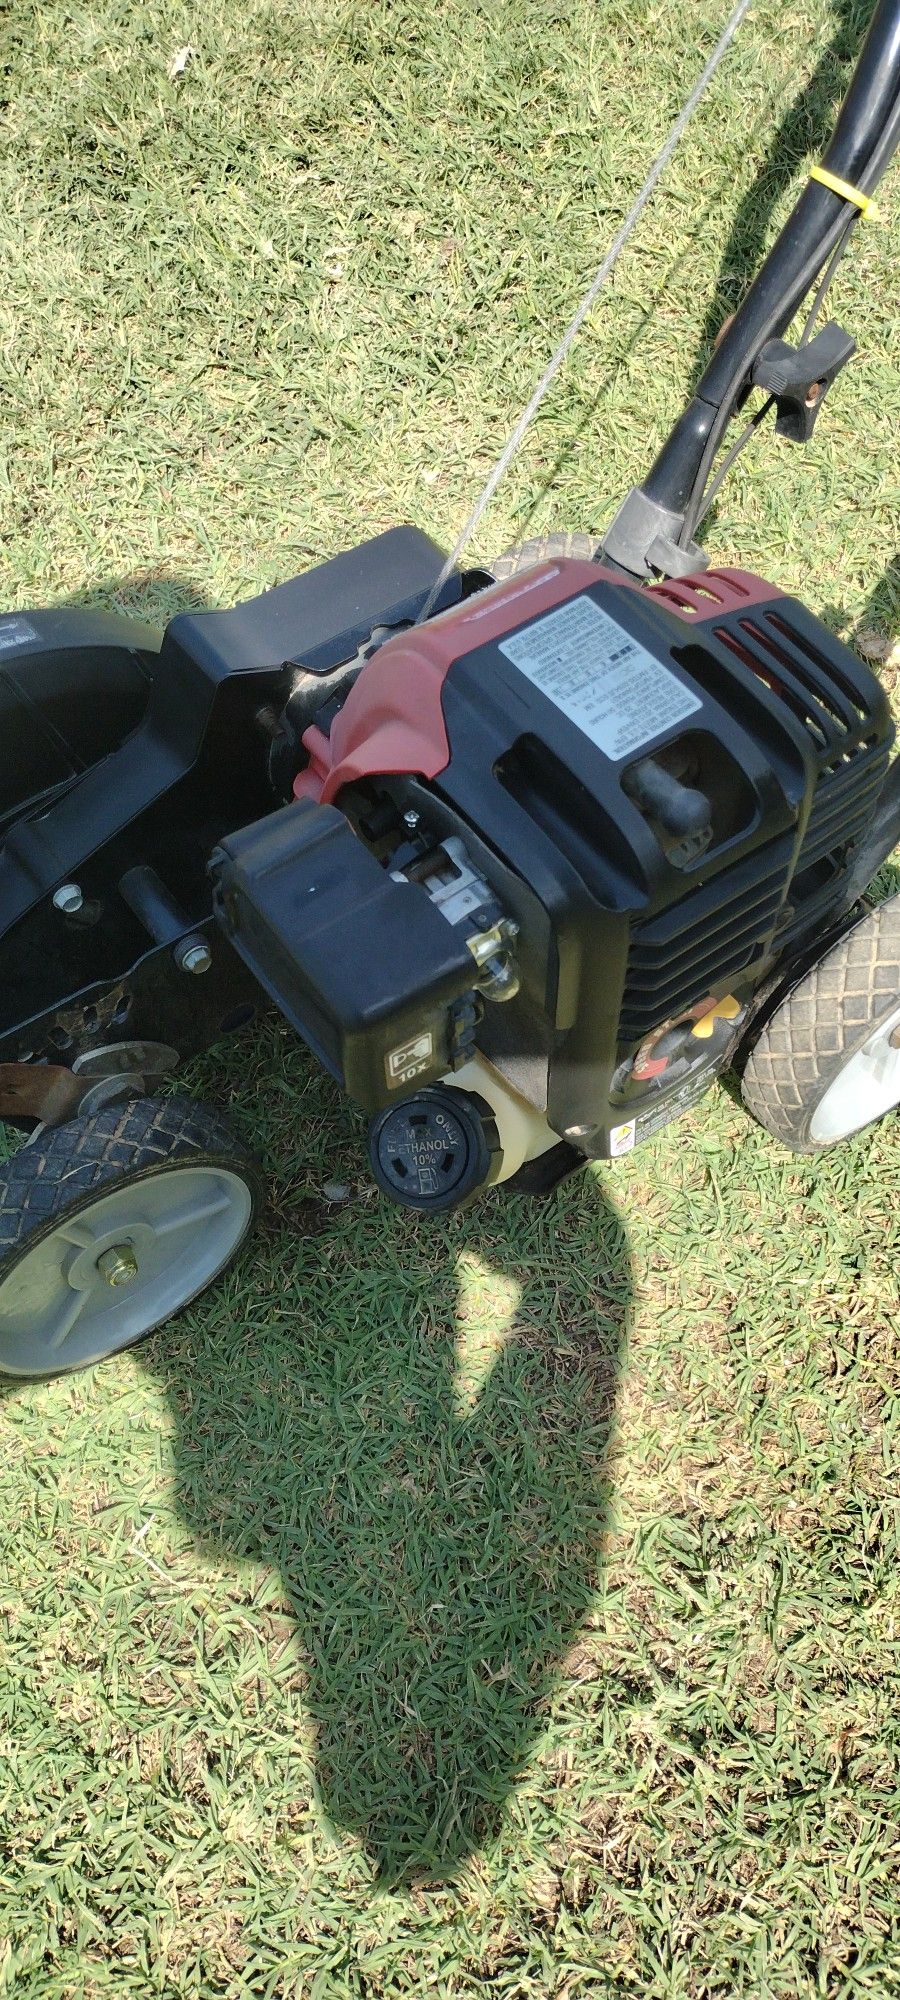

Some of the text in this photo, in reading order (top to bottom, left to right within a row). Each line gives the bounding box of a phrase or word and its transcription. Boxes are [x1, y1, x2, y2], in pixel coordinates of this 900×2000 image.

[436, 1114, 459, 1146] ONLY
[399, 1139, 449, 1155] ETHANOL
[413, 1154, 436, 1166] 10%
